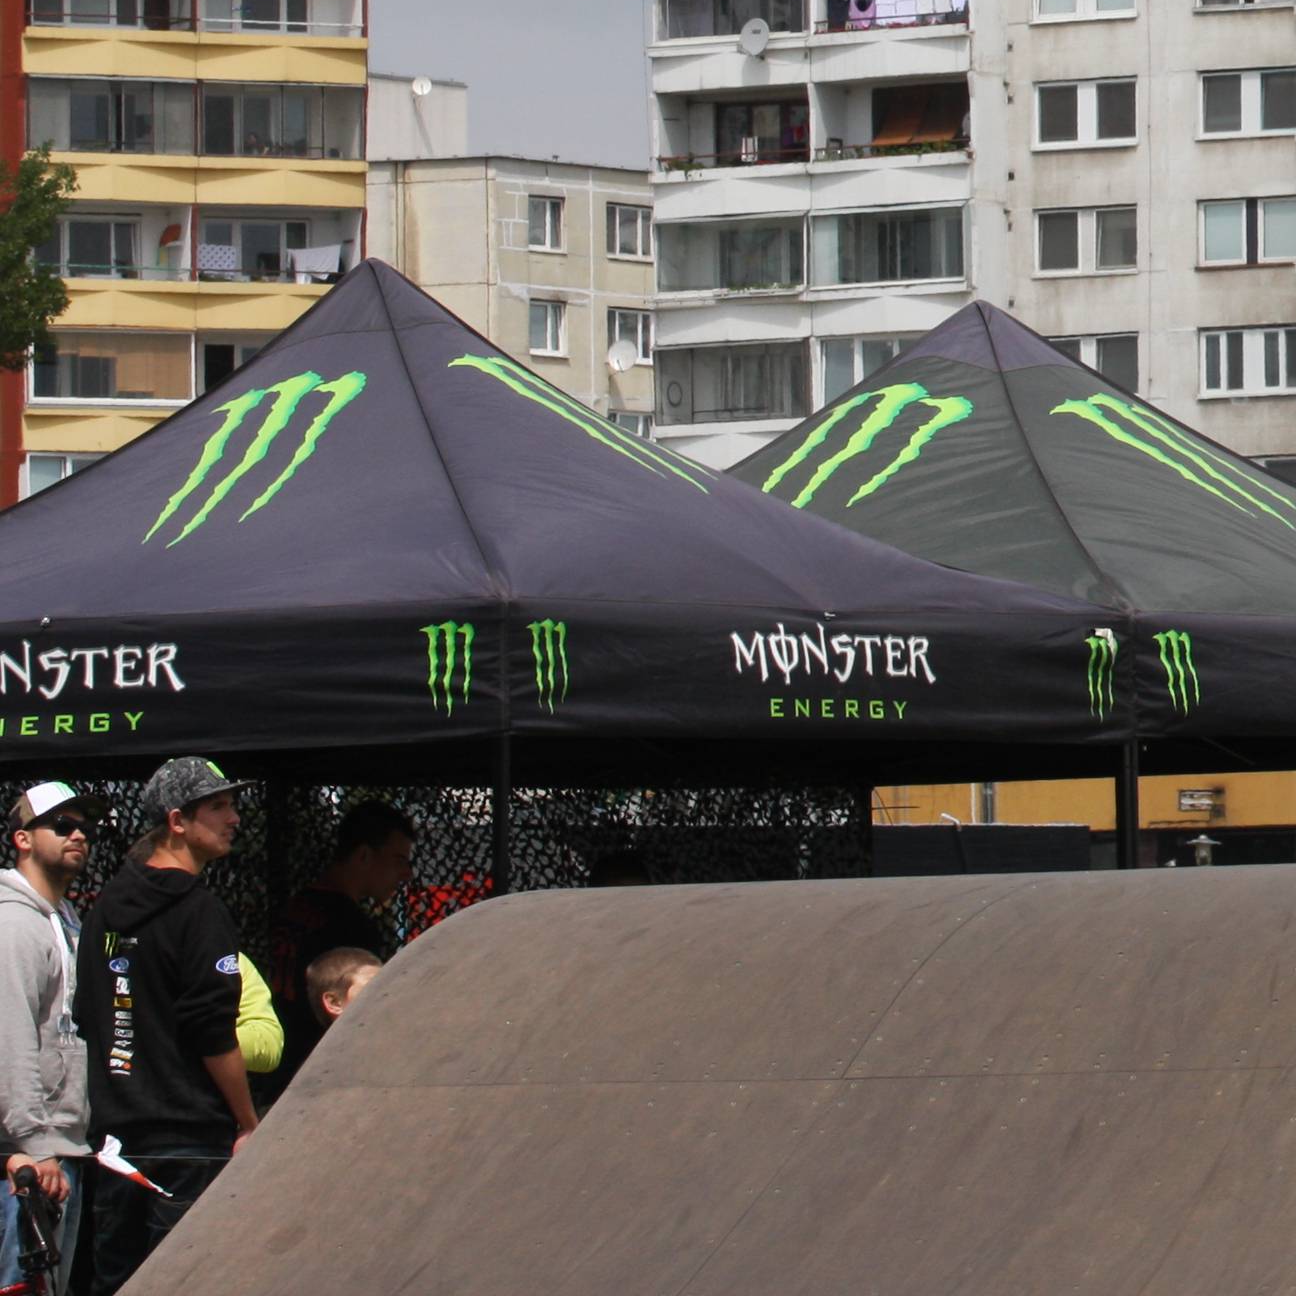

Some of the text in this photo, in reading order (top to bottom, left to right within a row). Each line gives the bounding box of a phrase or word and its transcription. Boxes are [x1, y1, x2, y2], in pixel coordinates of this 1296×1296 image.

[730, 622, 937, 686] MONSTER
[769, 697, 907, 720] ENERGY
[0, 711, 144, 737] ERGY
